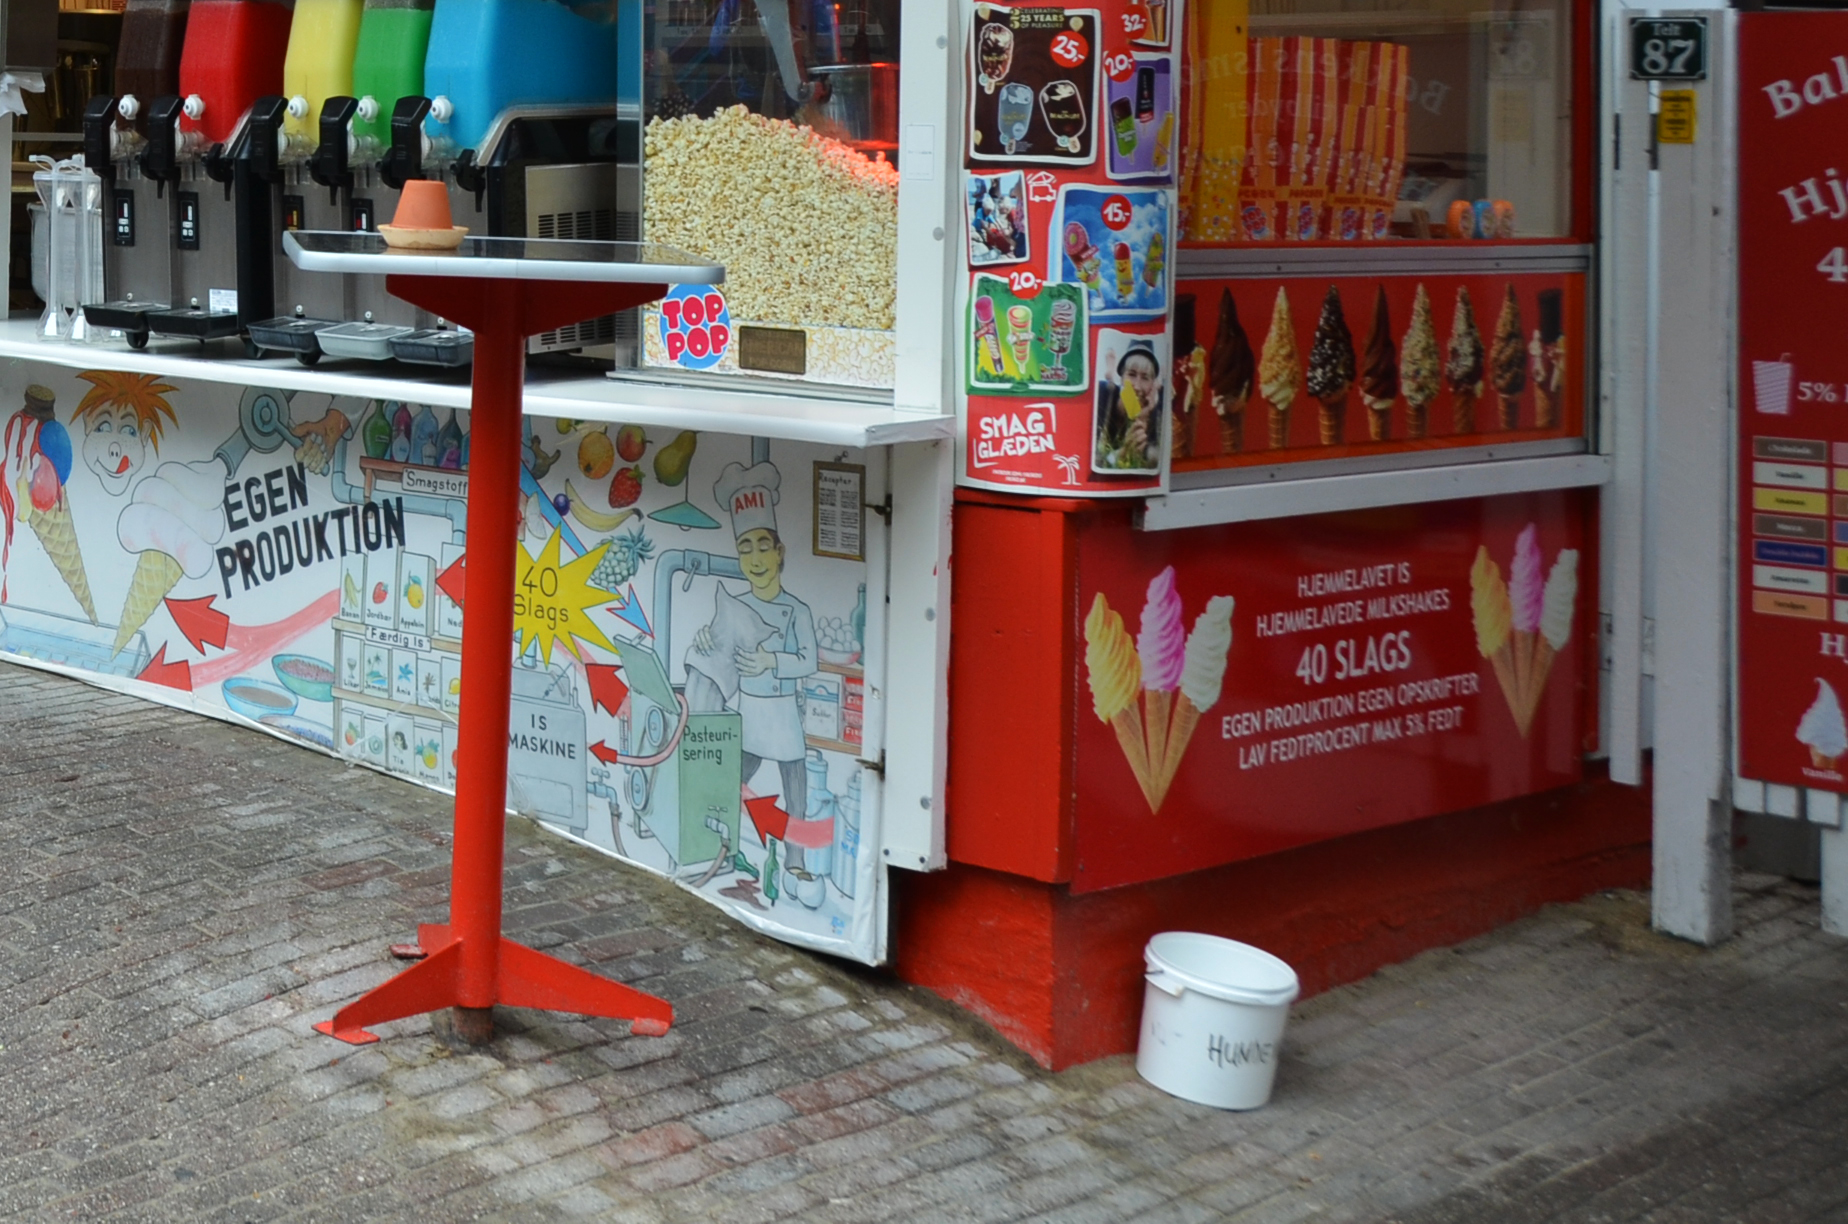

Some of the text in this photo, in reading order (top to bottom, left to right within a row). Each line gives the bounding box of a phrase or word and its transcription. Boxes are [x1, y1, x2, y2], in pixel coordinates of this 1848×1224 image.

[1034, 13, 1065, 23] YEARS
[1653, 23, 1682, 38] Telt
[1641, 38, 1697, 75] 87
[662, 293, 725, 330] TOP
[666, 323, 730, 362] POP
[1796, 381, 1838, 403] 5%
[979, 412, 1046, 440] SMAG
[977, 434, 1056, 460] GLÆDEN
[223, 462, 310, 532] EGEN
[734, 492, 766, 515] AMI
[215, 496, 406, 600] PRODUKTION
[522, 566, 559, 598] 40
[1297, 561, 1412, 599] HJEMMELAVET IS
[513, 593, 570, 631] Slags
[1256, 588, 1451, 638] HJEMMELAVEDE MILKSHAKES
[370, 627, 424, 648] Færdig Is
[1295, 630, 1412, 686] 40 SLAGS
[531, 713, 547, 731] IS
[1221, 672, 1480, 741] EGEN PRODUKTION EGEN OPSKRIFTER
[508, 732, 577, 760] MASKINE
[683, 726, 739, 745] Pasteuri-
[1239, 706, 1464, 770] LAV FEDTPROCENT MAX 5% FEDT
[683, 746, 724, 765] sering
